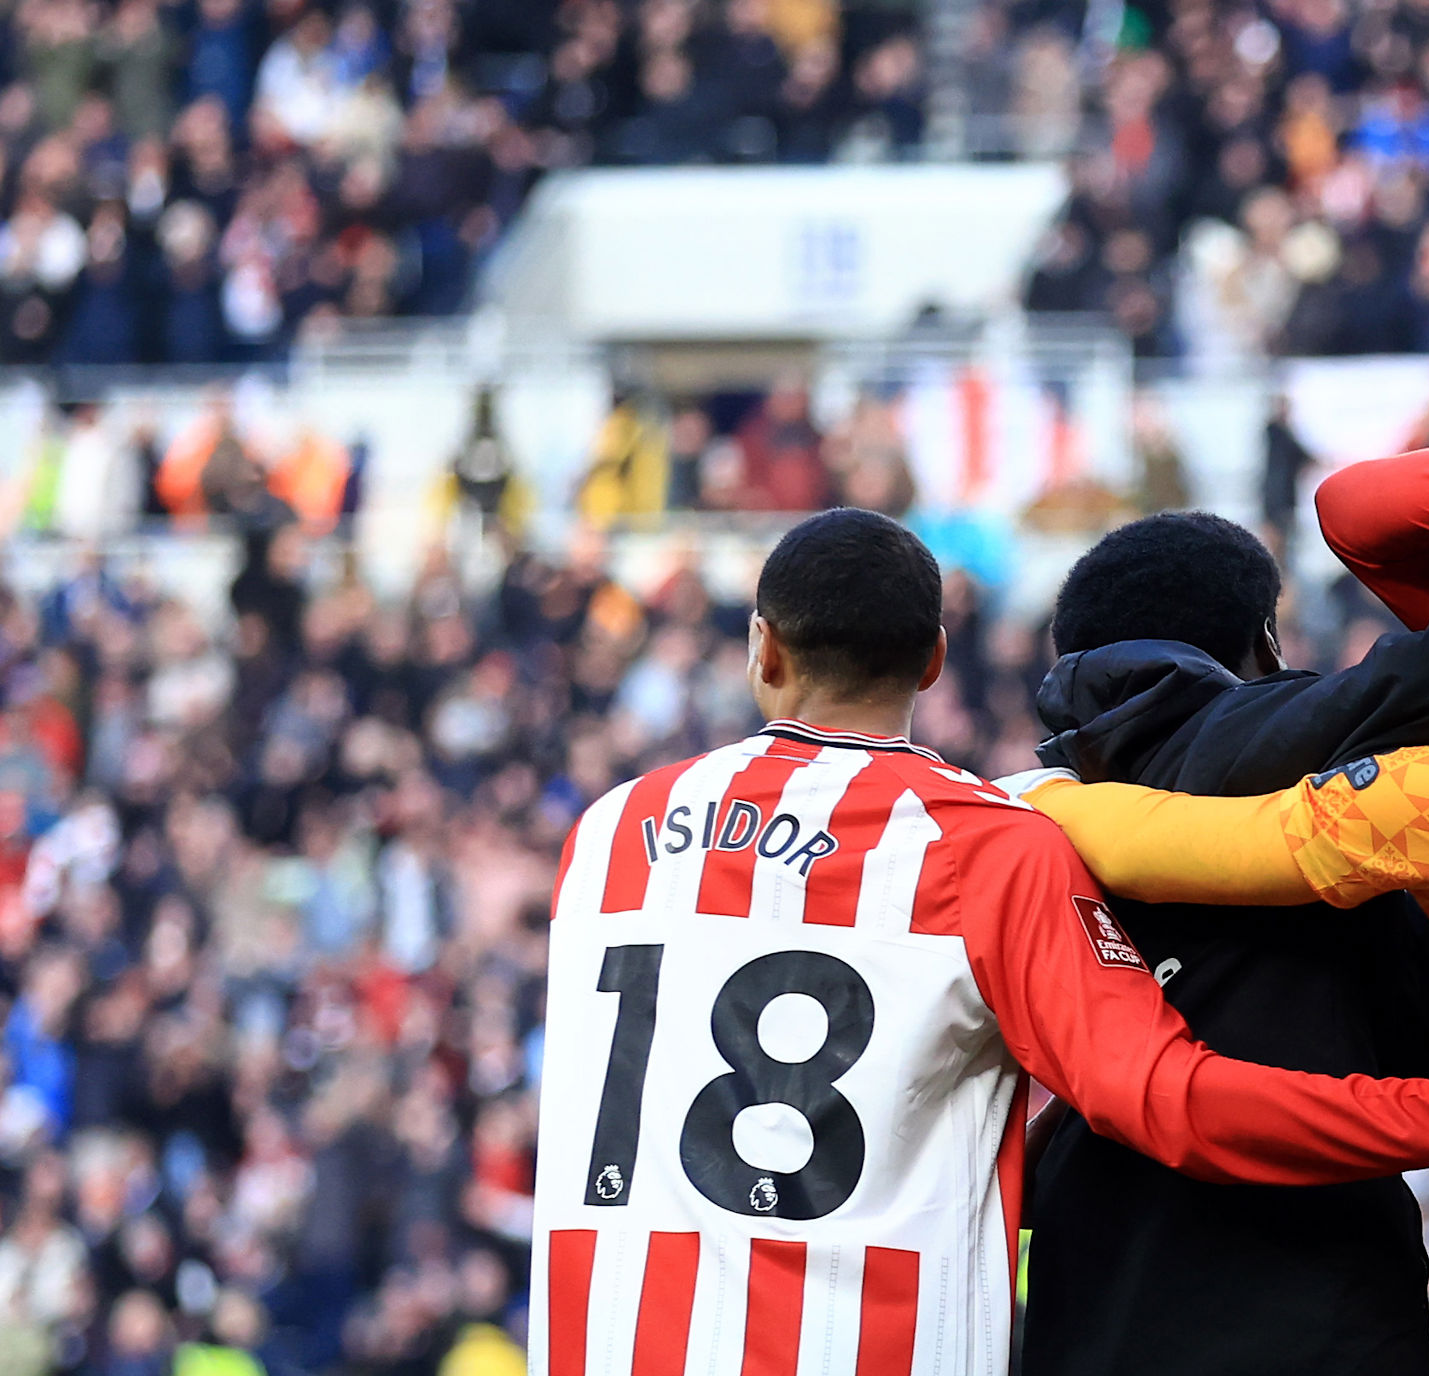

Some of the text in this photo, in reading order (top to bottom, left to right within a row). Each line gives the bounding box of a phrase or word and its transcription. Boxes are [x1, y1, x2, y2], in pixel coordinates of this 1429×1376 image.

[643, 799, 838, 877] ISIDOR
[1102, 950, 1140, 964] FA CUP
[584, 944, 876, 1221] 18
